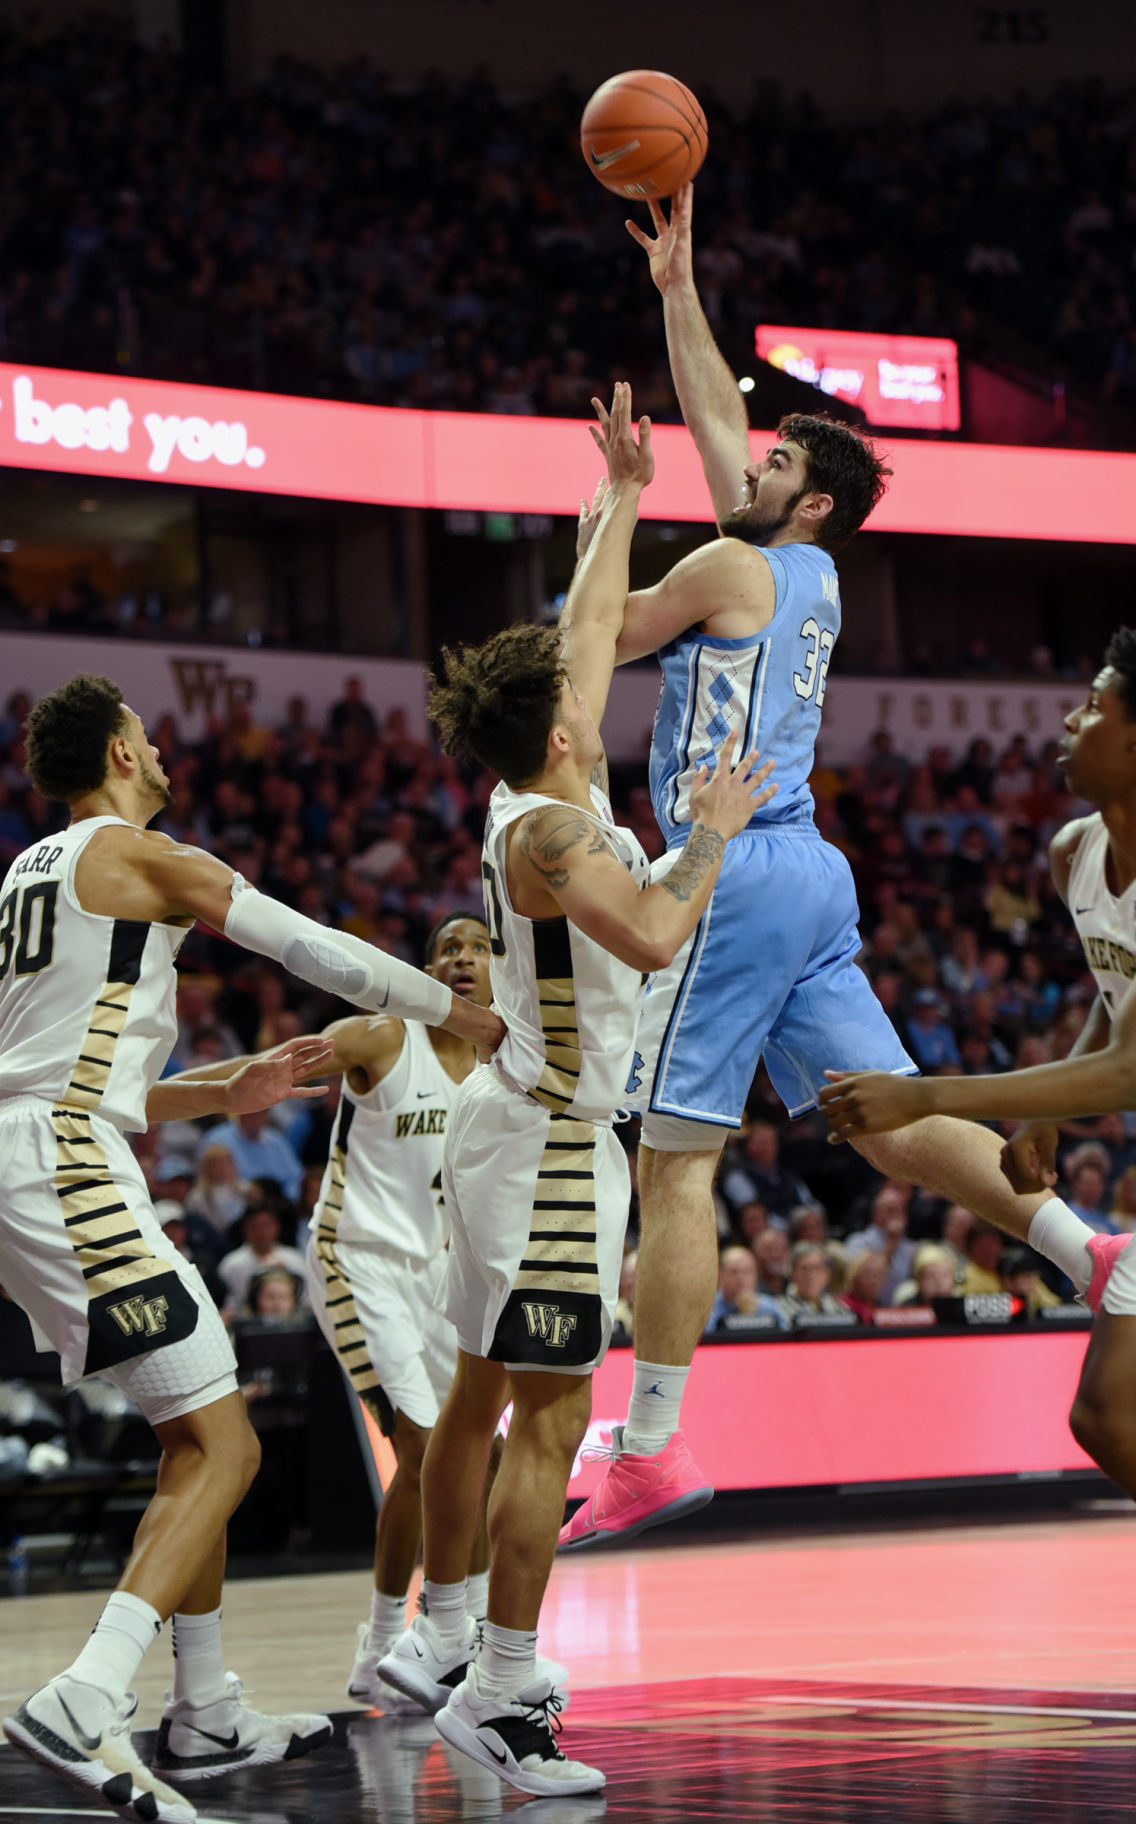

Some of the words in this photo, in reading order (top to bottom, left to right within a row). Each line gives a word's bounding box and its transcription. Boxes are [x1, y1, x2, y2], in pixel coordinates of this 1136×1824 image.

[13, 376, 132, 453] best
[144, 413, 265, 472] you.
[793, 617, 835, 708] 32
[395, 1108, 448, 1138] WAKE
[106, 1294, 169, 1337] WF
[521, 1302, 578, 1348] WF
